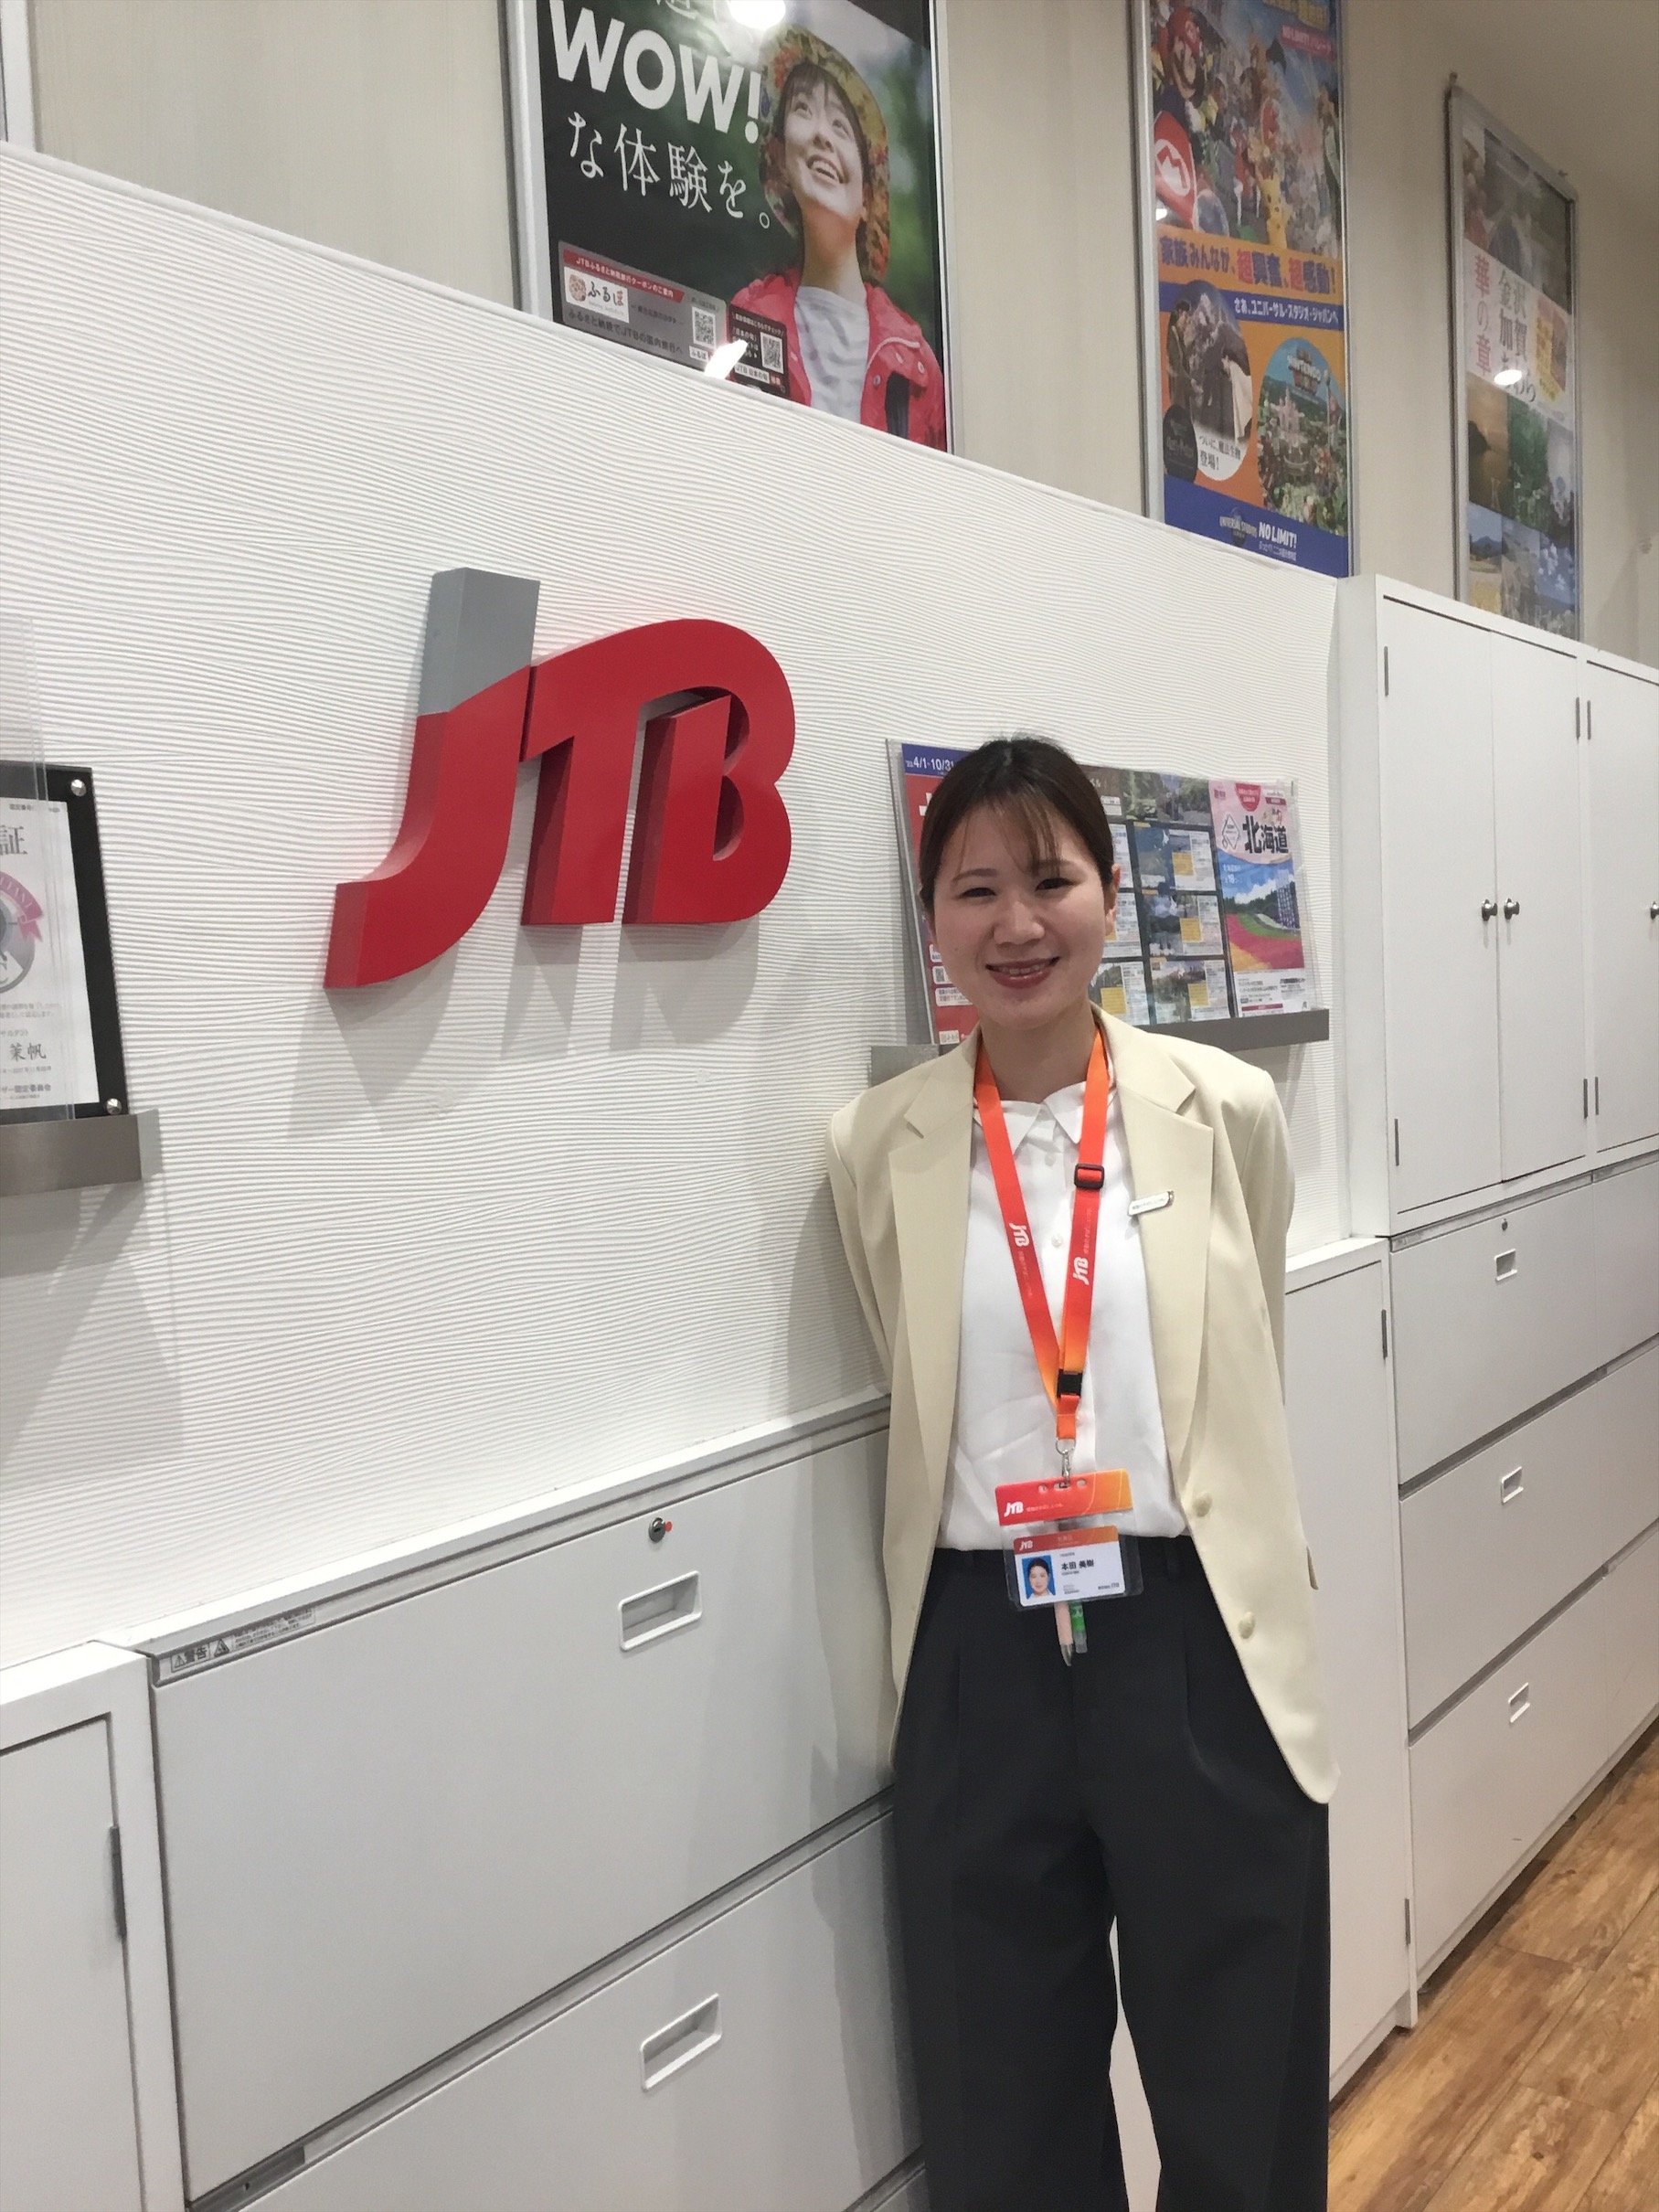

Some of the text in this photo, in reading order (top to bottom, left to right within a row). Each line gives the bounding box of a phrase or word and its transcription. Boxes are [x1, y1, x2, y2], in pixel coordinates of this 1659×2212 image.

[548, 0, 761, 144] WOW!
[567, 112, 771, 229] な体験を。
[588, 281, 625, 306] ふるぽ
[1259, 521, 1297, 549] NO LIMIT!
[323, 567, 796, 989] JTB
[1242, 814, 1289, 854] 北海道
[1009, 1222, 1030, 1248] JTB
[1072, 1256, 1090, 1286] JTB
[1004, 1501, 1025, 1518] JTB
[1018, 1539, 1034, 1552] JTB
[184, 1644, 208, 1663] 警告
